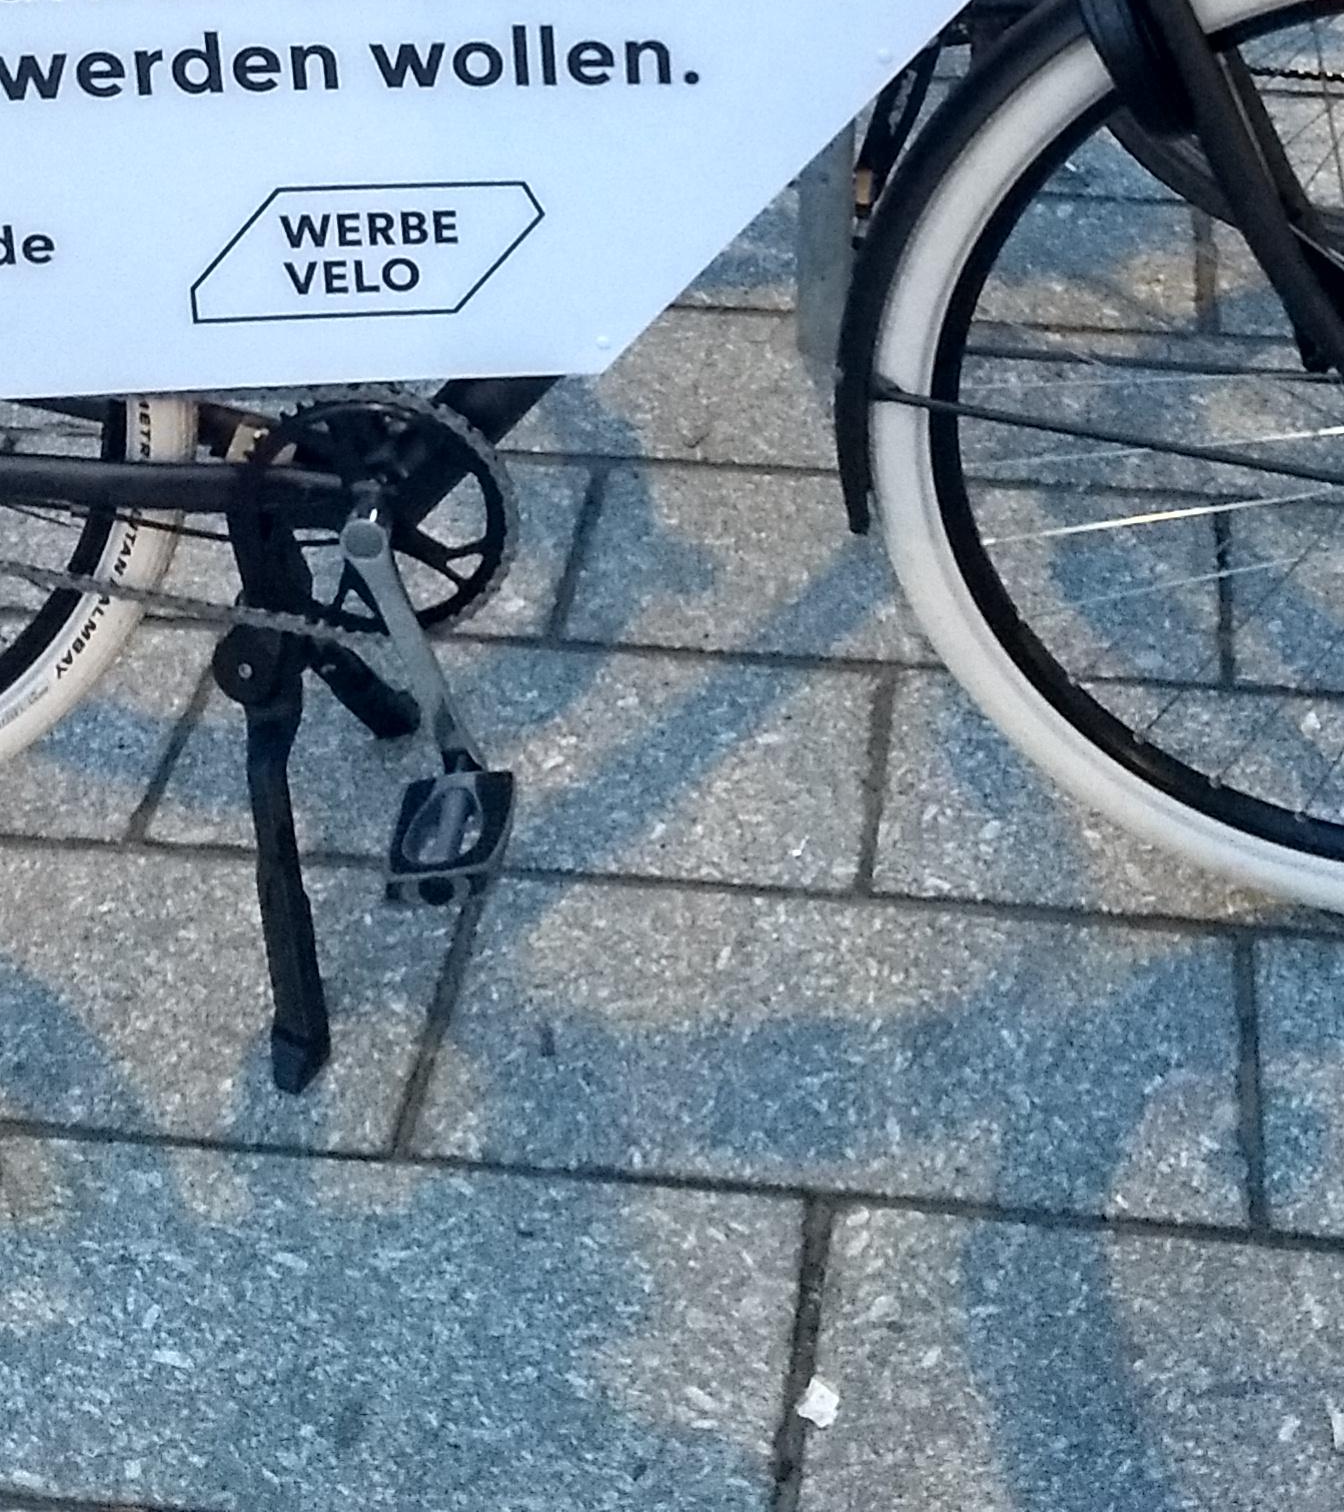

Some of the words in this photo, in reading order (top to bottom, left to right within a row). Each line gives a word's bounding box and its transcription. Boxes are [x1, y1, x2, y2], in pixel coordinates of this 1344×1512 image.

[368, 24, 700, 89] wollen.
[279, 210, 459, 249] WERBE
[283, 257, 420, 295] VELO
